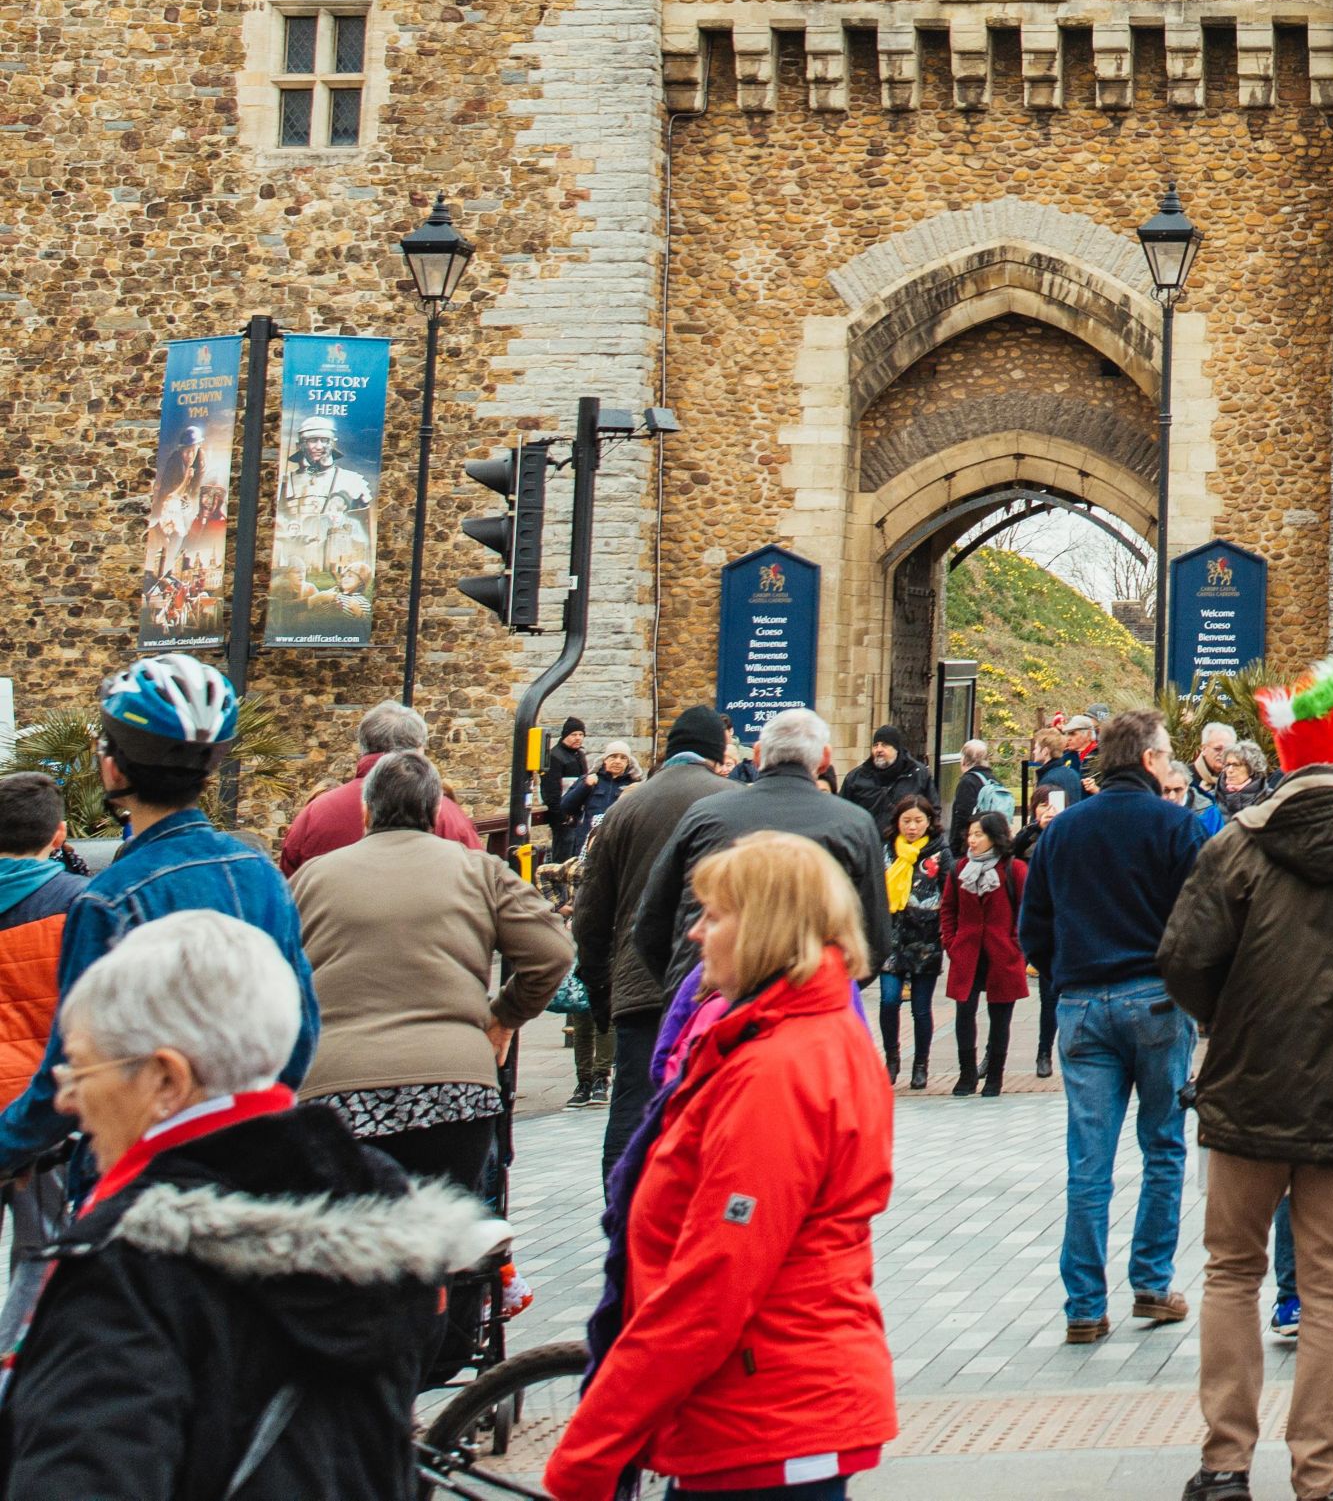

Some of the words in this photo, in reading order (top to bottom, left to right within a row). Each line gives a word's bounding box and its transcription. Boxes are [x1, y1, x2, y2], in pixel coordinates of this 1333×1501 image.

[297, 374, 324, 388] THE
[326, 374, 370, 388] STORY
[308, 389, 357, 402] STARTS
[315, 404, 348, 416] HERE
[1200, 609, 1235, 618] Welcome
[752, 615, 788, 624] Welcome
[1204, 621, 1231, 630] Croeso
[755, 627, 783, 636] Croeso
[275, 635, 360, 644] www.cardiffcastle.com
[1198, 633, 1236, 641] Bienvenue
[749, 639, 788, 648] Bienvenue
[1197, 645, 1236, 653] Benvenuto
[748, 651, 788, 660] Benvenuto
[1194, 656, 1239, 665] Willkommen
[744, 663, 791, 672] Willkommen
[747, 675, 788, 684] Bienvenido
[726, 700, 754, 709] добро
